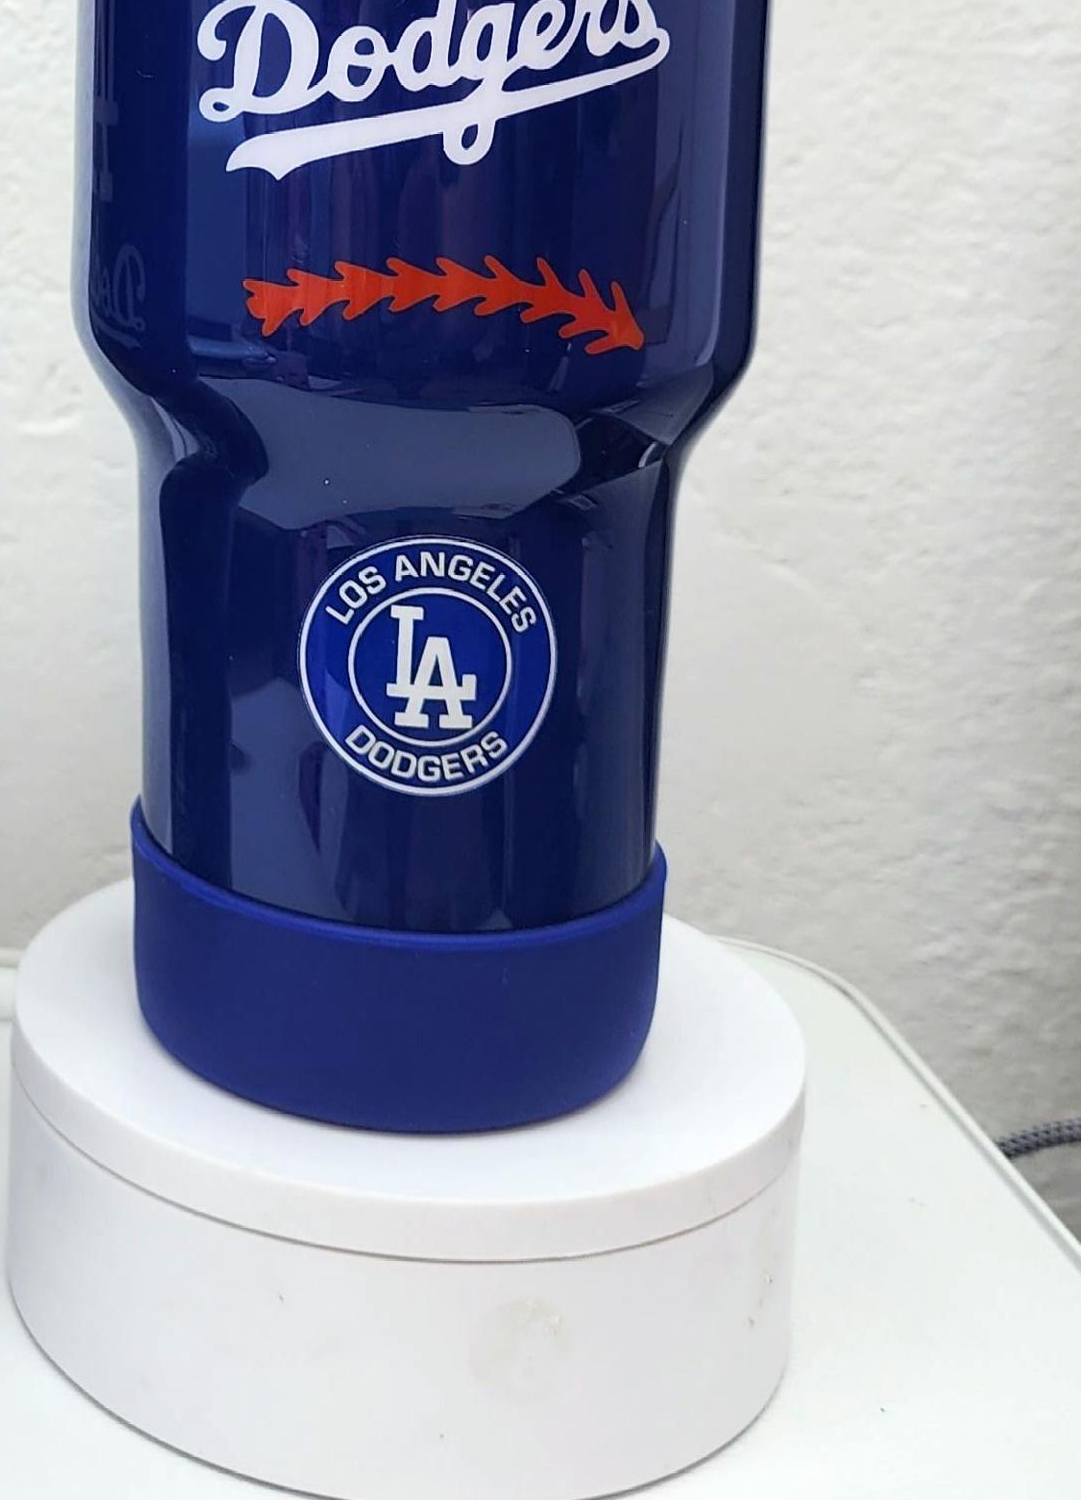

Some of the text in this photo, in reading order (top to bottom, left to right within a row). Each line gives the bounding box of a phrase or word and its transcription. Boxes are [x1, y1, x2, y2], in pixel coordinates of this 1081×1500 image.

[325, 551, 537, 633] LOS ANGELES
[386, 604, 477, 729] LA
[345, 724, 509, 782] DODGERS
